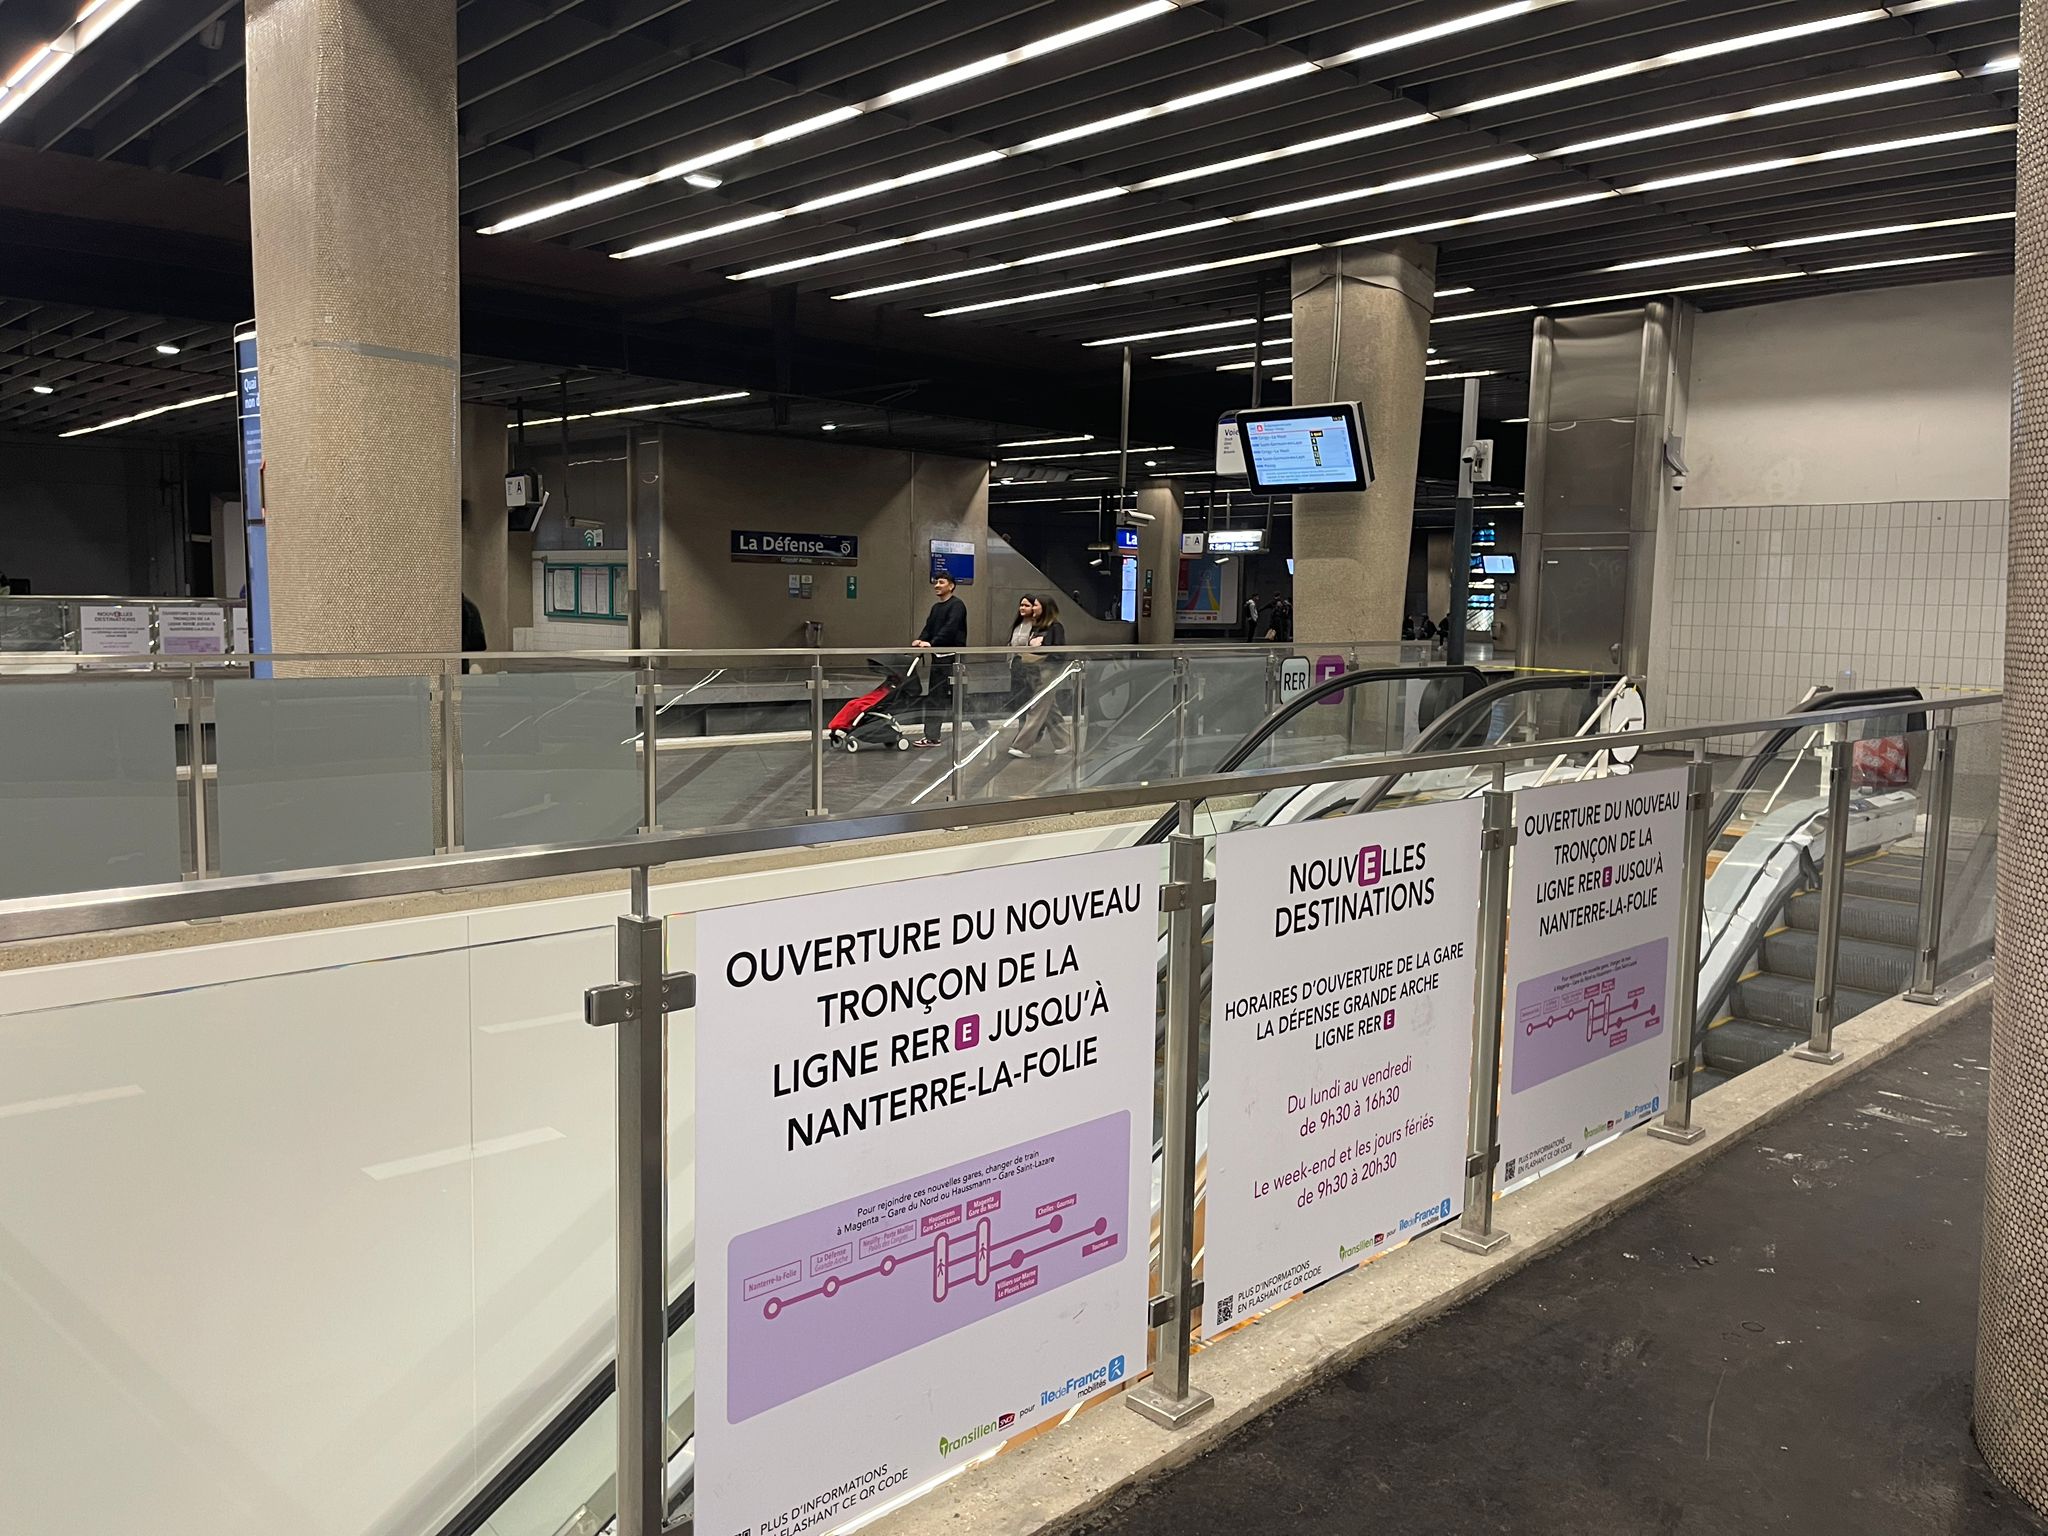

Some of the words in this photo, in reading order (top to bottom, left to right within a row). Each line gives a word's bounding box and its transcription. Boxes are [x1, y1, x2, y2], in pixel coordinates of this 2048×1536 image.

[244, 376, 257, 393] Quai
[740, 535, 758, 550] La
[762, 536, 824, 553] Défense
[1126, 532, 1138, 546] La
[1194, 536, 1200, 545] A
[1284, 672, 1306, 691] RER
[1524, 804, 1601, 837] OUVERTURE
[1604, 801, 1622, 822] DU
[1625, 791, 1680, 818] NOUVEAU
[1289, 842, 1426, 894] NOUVELLES
[1554, 834, 1617, 865] TRONÇON
[1620, 830, 1636, 851] DE
[1639, 827, 1653, 846] LA
[1536, 876, 1575, 904] LIGNE
[1578, 870, 1601, 893] RER
[1615, 851, 1664, 884] JUSQU'À
[1275, 877, 1435, 938] DESTINATIONS
[1539, 887, 1658, 937] NANTERRE-LA-FOLIE
[726, 918, 940, 988] OUVERTURE
[952, 908, 995, 945] DU
[1006, 883, 1141, 935] NOUVEAU
[817, 964, 987, 1028] TRONÇON
[998, 956, 1036, 988] DE
[1045, 944, 1079, 978] LA
[1225, 985, 1298, 1022] HORAIRES
[1302, 960, 1393, 1001] D'OUVERTURE
[1397, 955, 1413, 974] DE
[1416, 951, 1430, 970] LA
[1433, 942, 1464, 964] GARE
[1257, 1019, 1274, 1040] LA
[1278, 1002, 1339, 1035] DÉFENSE
[1343, 985, 1396, 1014] GRANDE
[1399, 973, 1439, 999] ARCHE
[773, 1040, 878, 1098] LIGNE
[891, 1024, 950, 1068] RER
[988, 980, 1109, 1042] JUSQU'À
[1315, 1024, 1354, 1050] LIGNE
[1358, 1015, 1381, 1037] RER
[786, 1036, 1098, 1152] NANTERRE-LA-FOLIE
[1287, 1095, 1306, 1114] Du
[1310, 1080, 1341, 1107] lundi
[1344, 1078, 1358, 1093] au
[1362, 1055, 1413, 1087] vendredi
[1300, 1117, 1316, 1137] de
[1320, 1103, 1350, 1130] 9h30
[1353, 1101, 1361, 1117] à
[1365, 1085, 1400, 1113] 16h30
[1254, 1180, 1270, 1200] Le
[1274, 1149, 1336, 1191] week-end
[1339, 1147, 1352, 1165] et
[1355, 1139, 1371, 1159] les
[1373, 1127, 1402, 1154] jours
[1405, 1112, 1434, 1138] fériés
[1297, 1189, 1314, 1208] de
[1317, 1172, 1348, 1199] 9h30
[1350, 1168, 1358, 1185] à
[1362, 1151, 1397, 1182] 20h30
[836, 1226, 842, 1236] à
[844, 1215, 879, 1234] Magenta
[887, 1206, 906, 1218] Gare
[908, 1200, 918, 1210] du
[920, 1194, 939, 1207] Nord
[940, 1192, 950, 1202] ou
[951, 1177, 991, 1198] Haussmann
[998, 1169, 1015, 1181] Gare
[1016, 1156, 1055, 1175] Saint-Lazare
[857, 1205, 876, 1217] Pour
[877, 1194, 912, 1211] rejoindre
[913, 1189, 926, 1198] ces
[927, 1176, 961, 1192] nouvelles
[962, 1169, 984, 1185] gares,
[985, 1158, 1013, 1175] changer
[1014, 1155, 1023, 1165] de
[1024, 1150, 1040, 1162] train
[968, 1208, 980, 1218] Gare
[986, 1201, 999, 1211] Nord
[814, 1260, 833, 1272] Grande
[834, 1255, 848, 1266] Arche
[824, 1248, 846, 1261] Défense
[1340, 1238, 1374, 1262] Transilien
[1386, 1229, 1396, 1238] pour
[749, 1269, 797, 1292] Nanterre-la-Folie
[1238, 1287, 1254, 1302] PLUS
[1255, 1260, 1310, 1292] D'INFORMATIONS
[1238, 1303, 1247, 1313] EN
[1248, 1285, 1282, 1308] FLASHANT
[1283, 1281, 1292, 1290] CE
[1293, 1276, 1302, 1286] QR
[1304, 1266, 1322, 1280] CODE
[1077, 1378, 1107, 1398] mobilités
[939, 1420, 997, 1458] Transilien
[999, 1415, 1013, 1426] SNCF
[1019, 1404, 1035, 1418] pour
[760, 1512, 788, 1535] PLUS
[791, 1463, 888, 1520] D'INFORMATIONS
[780, 1502, 839, 1536] FLASHANT
[842, 1494, 857, 1510] CE
[859, 1485, 875, 1501] QR
[878, 1468, 909, 1491] CODE
